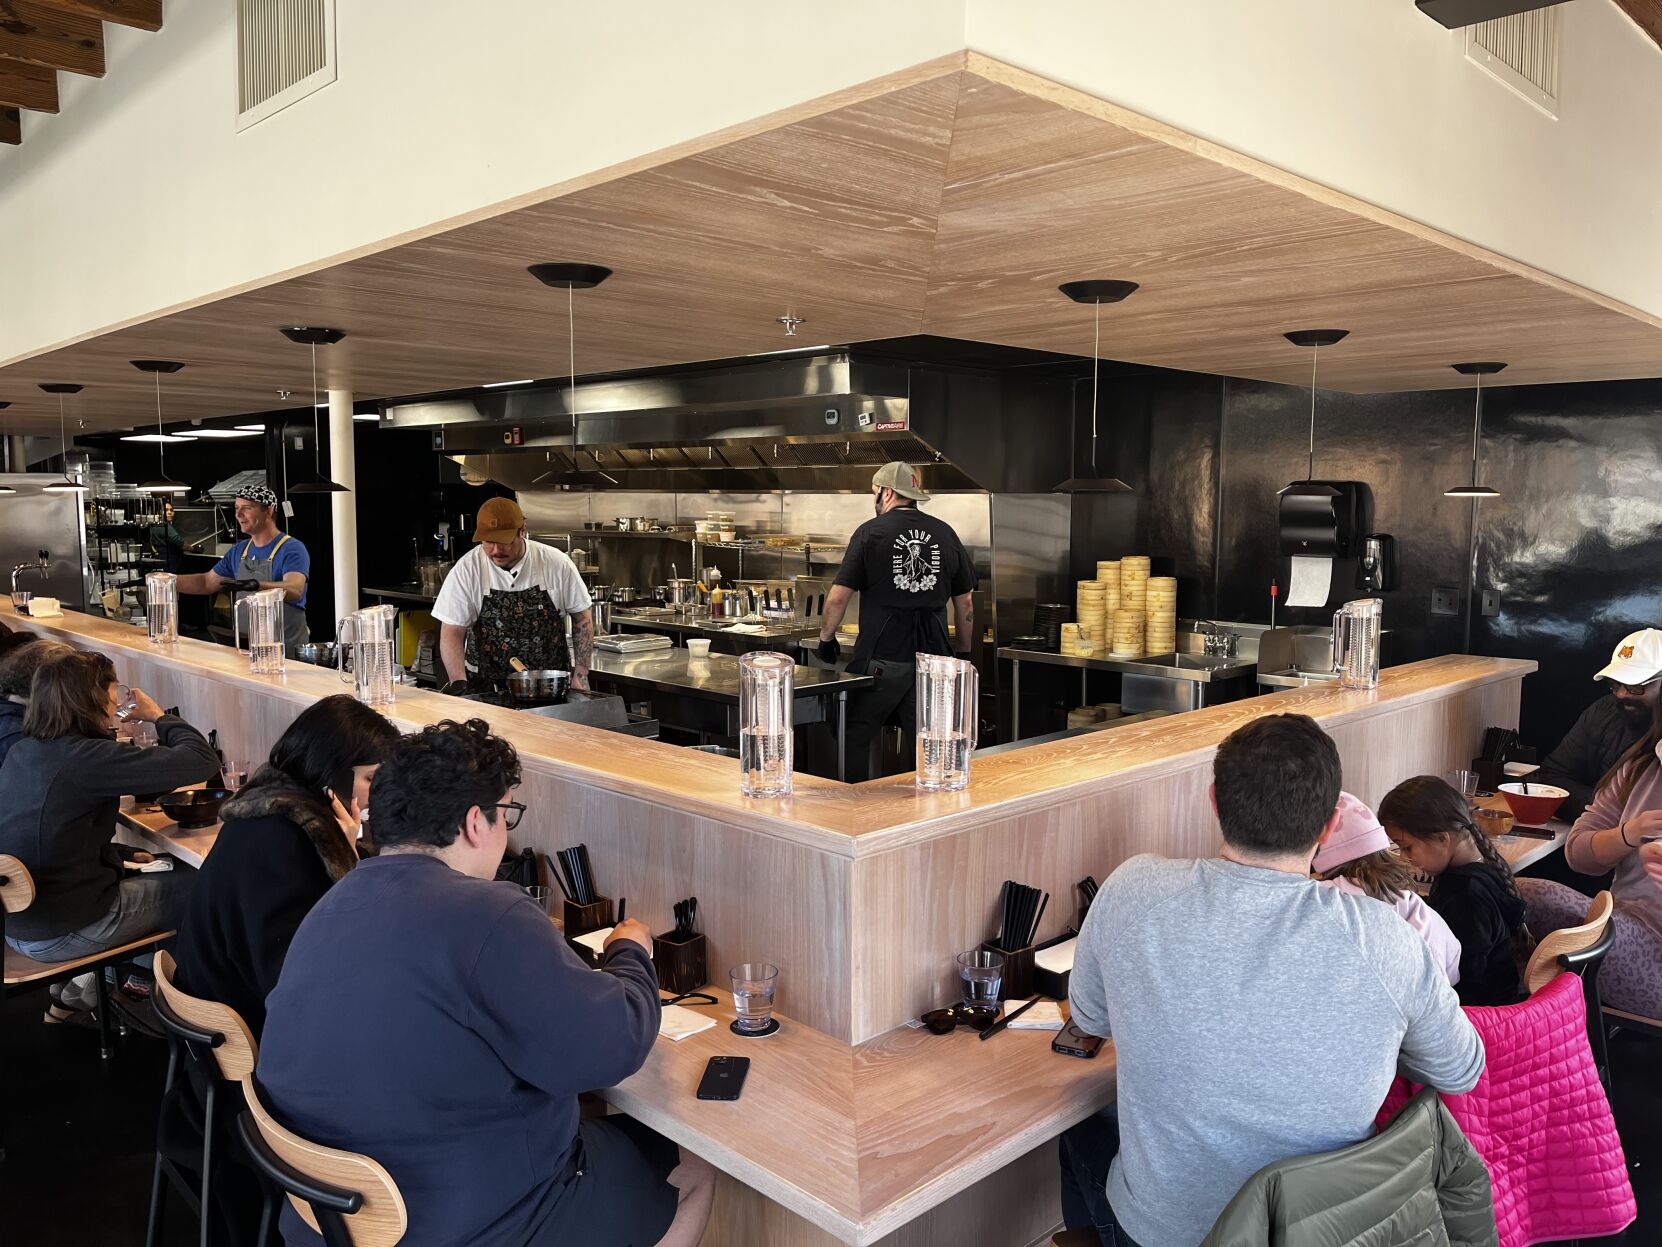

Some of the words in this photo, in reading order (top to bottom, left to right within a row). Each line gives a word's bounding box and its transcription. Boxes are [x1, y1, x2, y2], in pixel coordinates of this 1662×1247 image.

[893, 534, 908, 550] FOR
[908, 529, 932, 543] YOUR
[893, 555, 903, 574] HERE
[930, 544, 940, 574] PHOBIA
